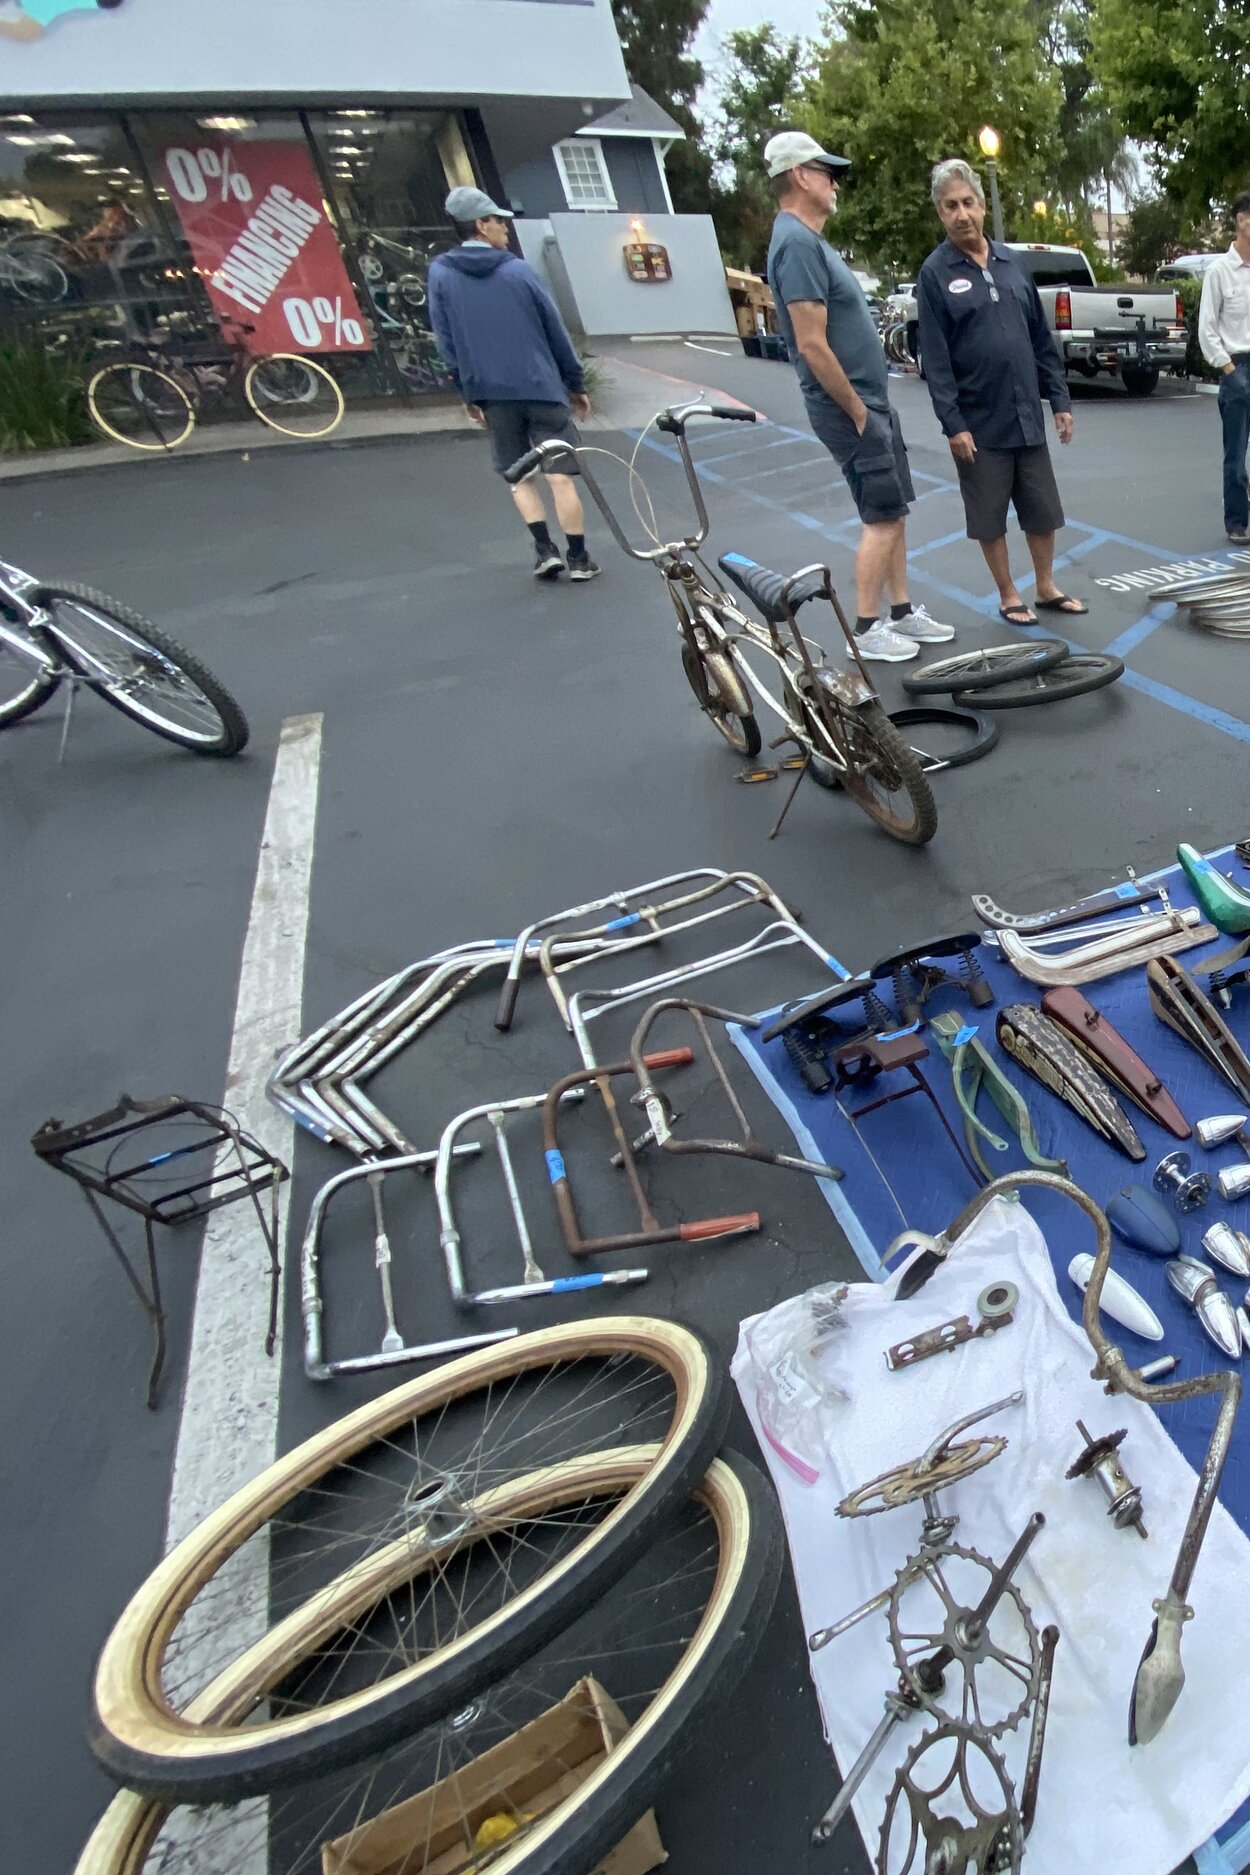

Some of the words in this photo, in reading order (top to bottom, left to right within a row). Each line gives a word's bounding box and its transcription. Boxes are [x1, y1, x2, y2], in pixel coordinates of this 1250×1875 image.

[165, 147, 253, 203] 0%
[210, 184, 322, 314] FINANCING
[283, 296, 364, 347] 0%
[1095, 558, 1235, 592] PARKING
